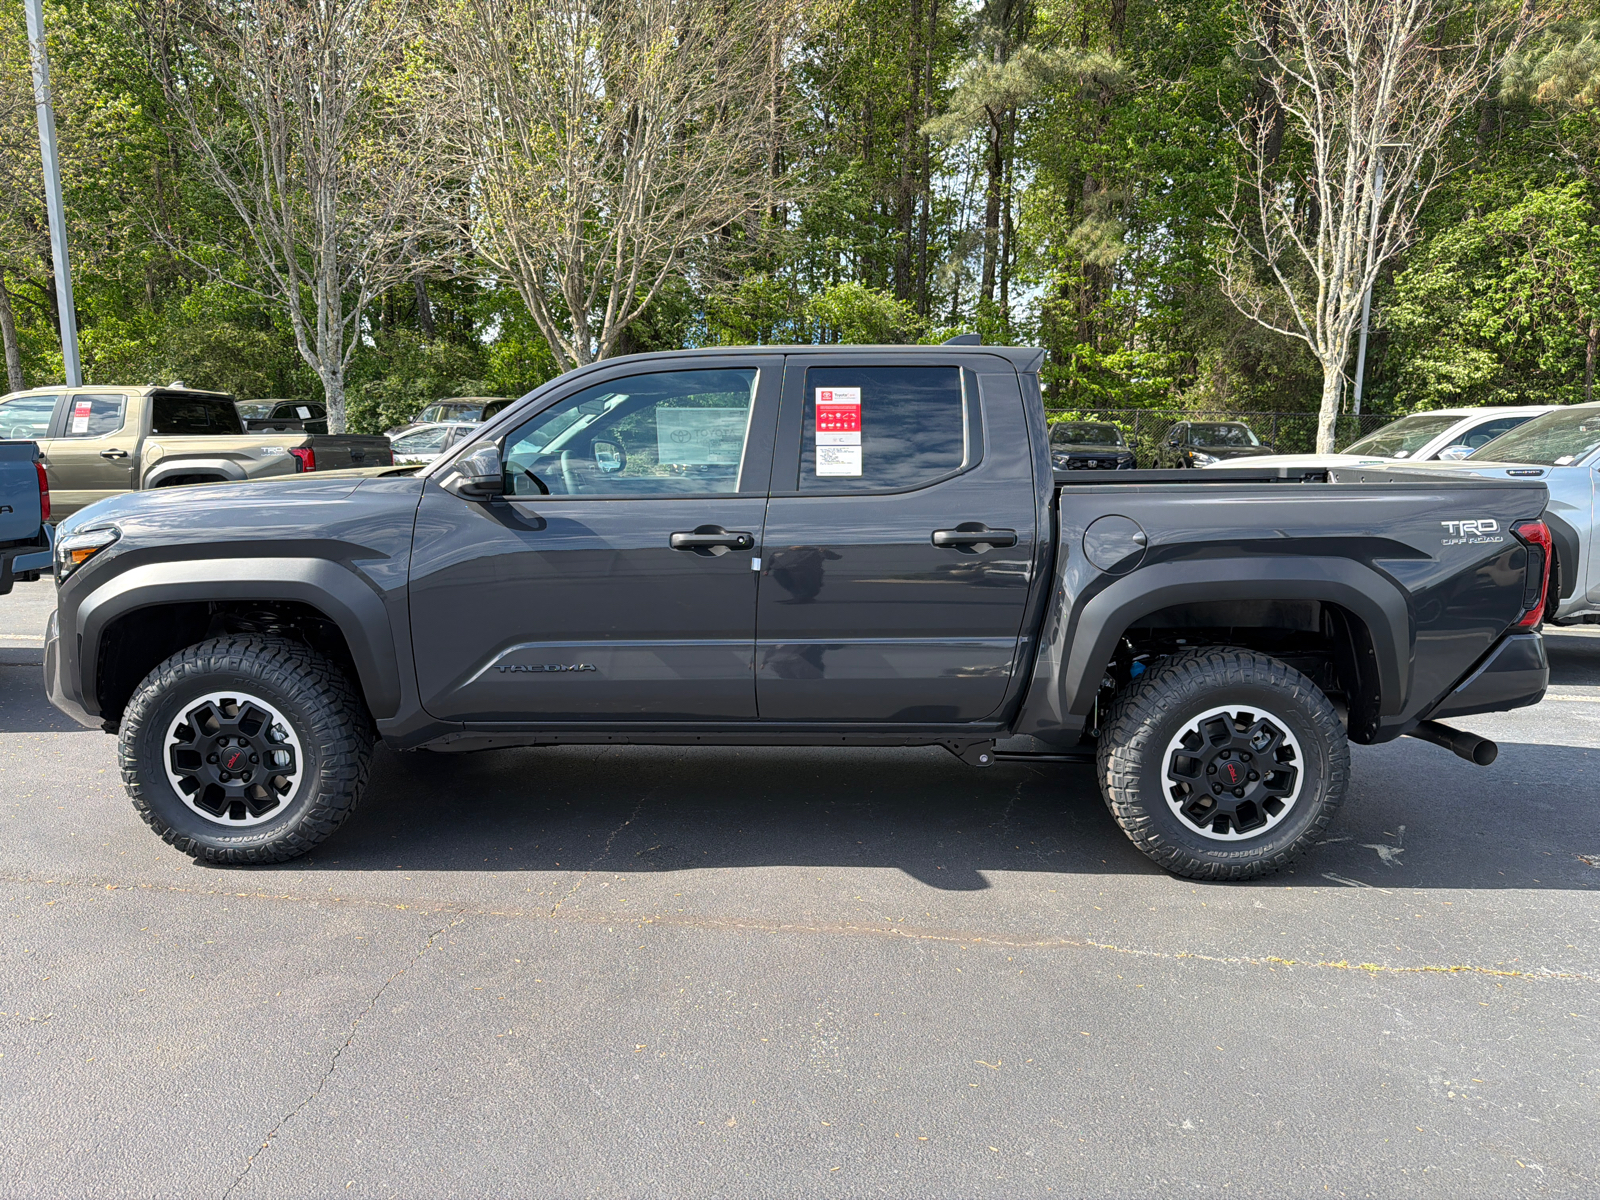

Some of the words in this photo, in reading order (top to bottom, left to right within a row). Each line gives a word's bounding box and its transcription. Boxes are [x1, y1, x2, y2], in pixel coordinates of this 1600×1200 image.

[260, 446, 284, 454] TRD
[1441, 519, 1499, 537] TRD
[1441, 538, 1467, 546] OFF
[1469, 536, 1504, 544] ROAD
[493, 664, 597, 673] TACOMA
[227, 752, 241, 769] TRD
[1227, 763, 1238, 784] TRD
